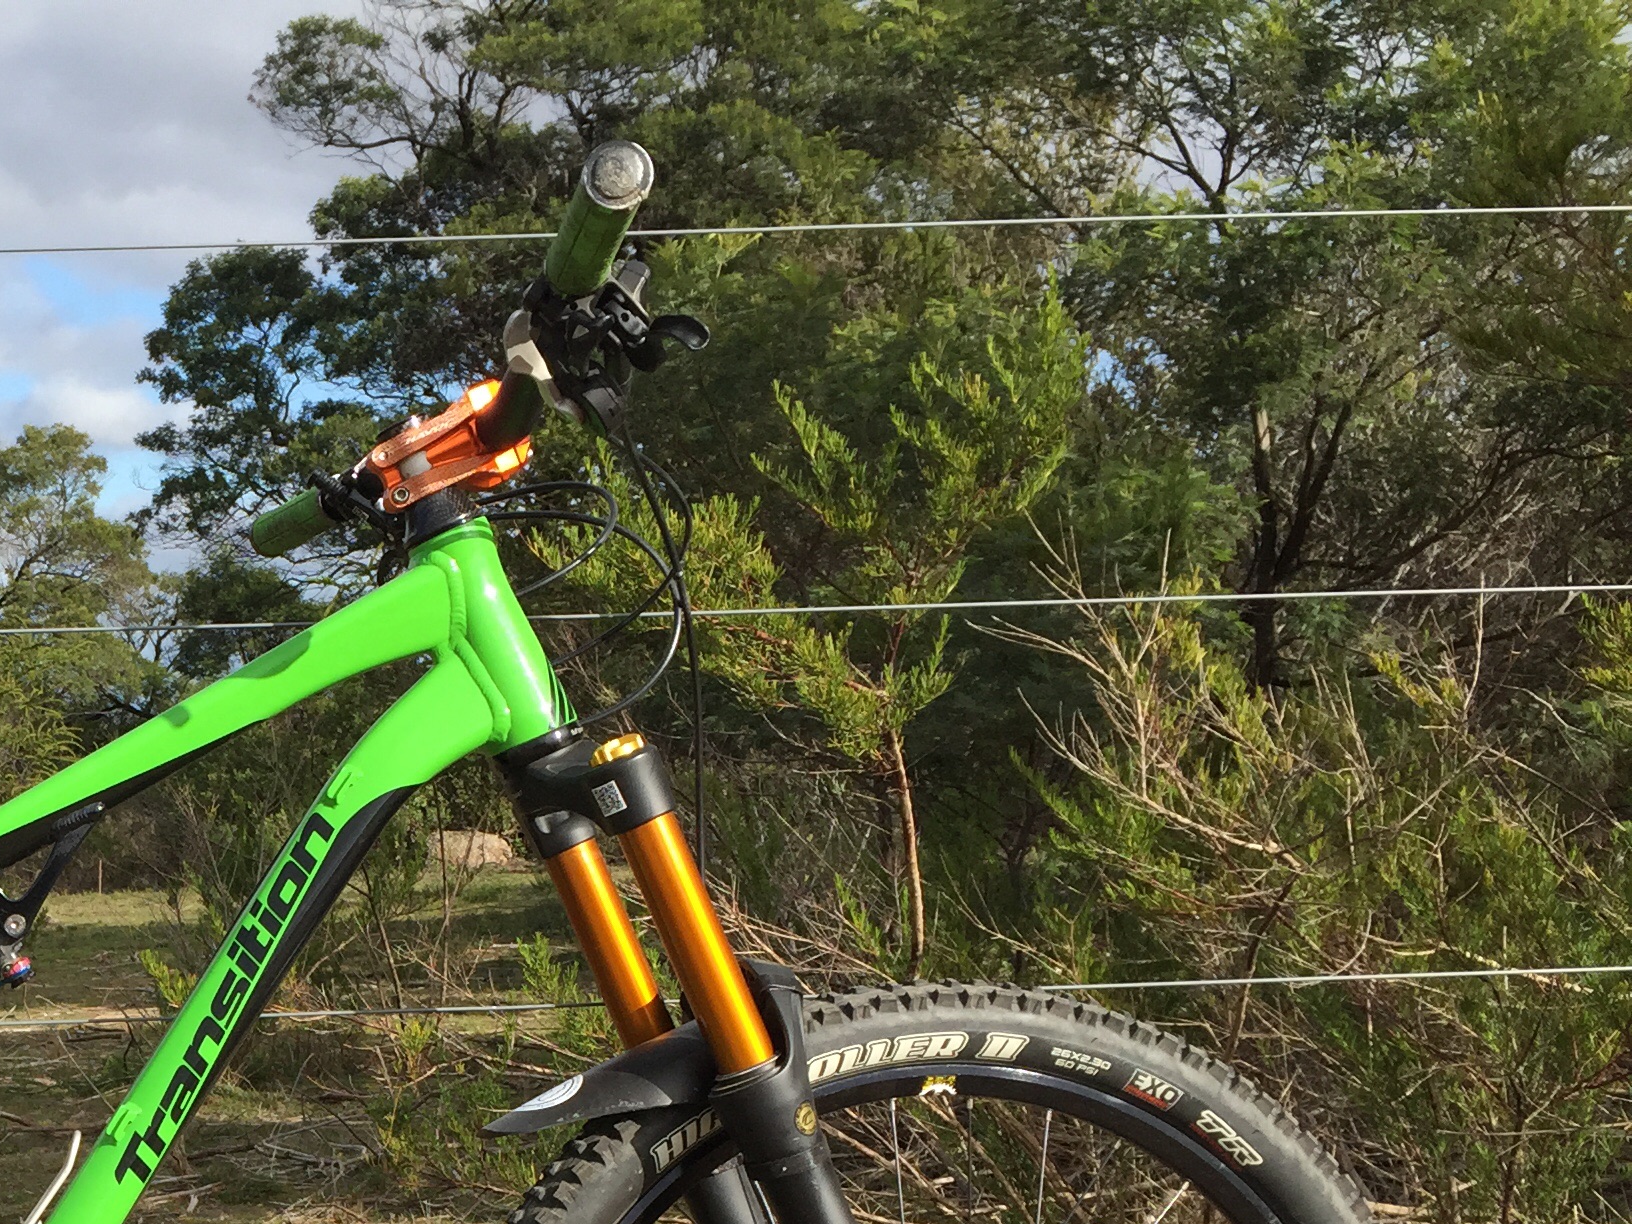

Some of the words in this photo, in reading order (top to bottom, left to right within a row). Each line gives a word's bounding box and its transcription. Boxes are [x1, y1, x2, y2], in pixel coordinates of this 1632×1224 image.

[114, 812, 335, 1185] Transition
[1050, 1047, 1112, 1071] 26X2.30
[1054, 1058, 1074, 1070] 60
[1074, 1061, 1100, 1076] PSI
[649, 1106, 723, 1174] HIG
[808, 1031, 970, 1084] OLLER
[1130, 1069, 1183, 1104] EXO
[1196, 1109, 1264, 1166] TR
